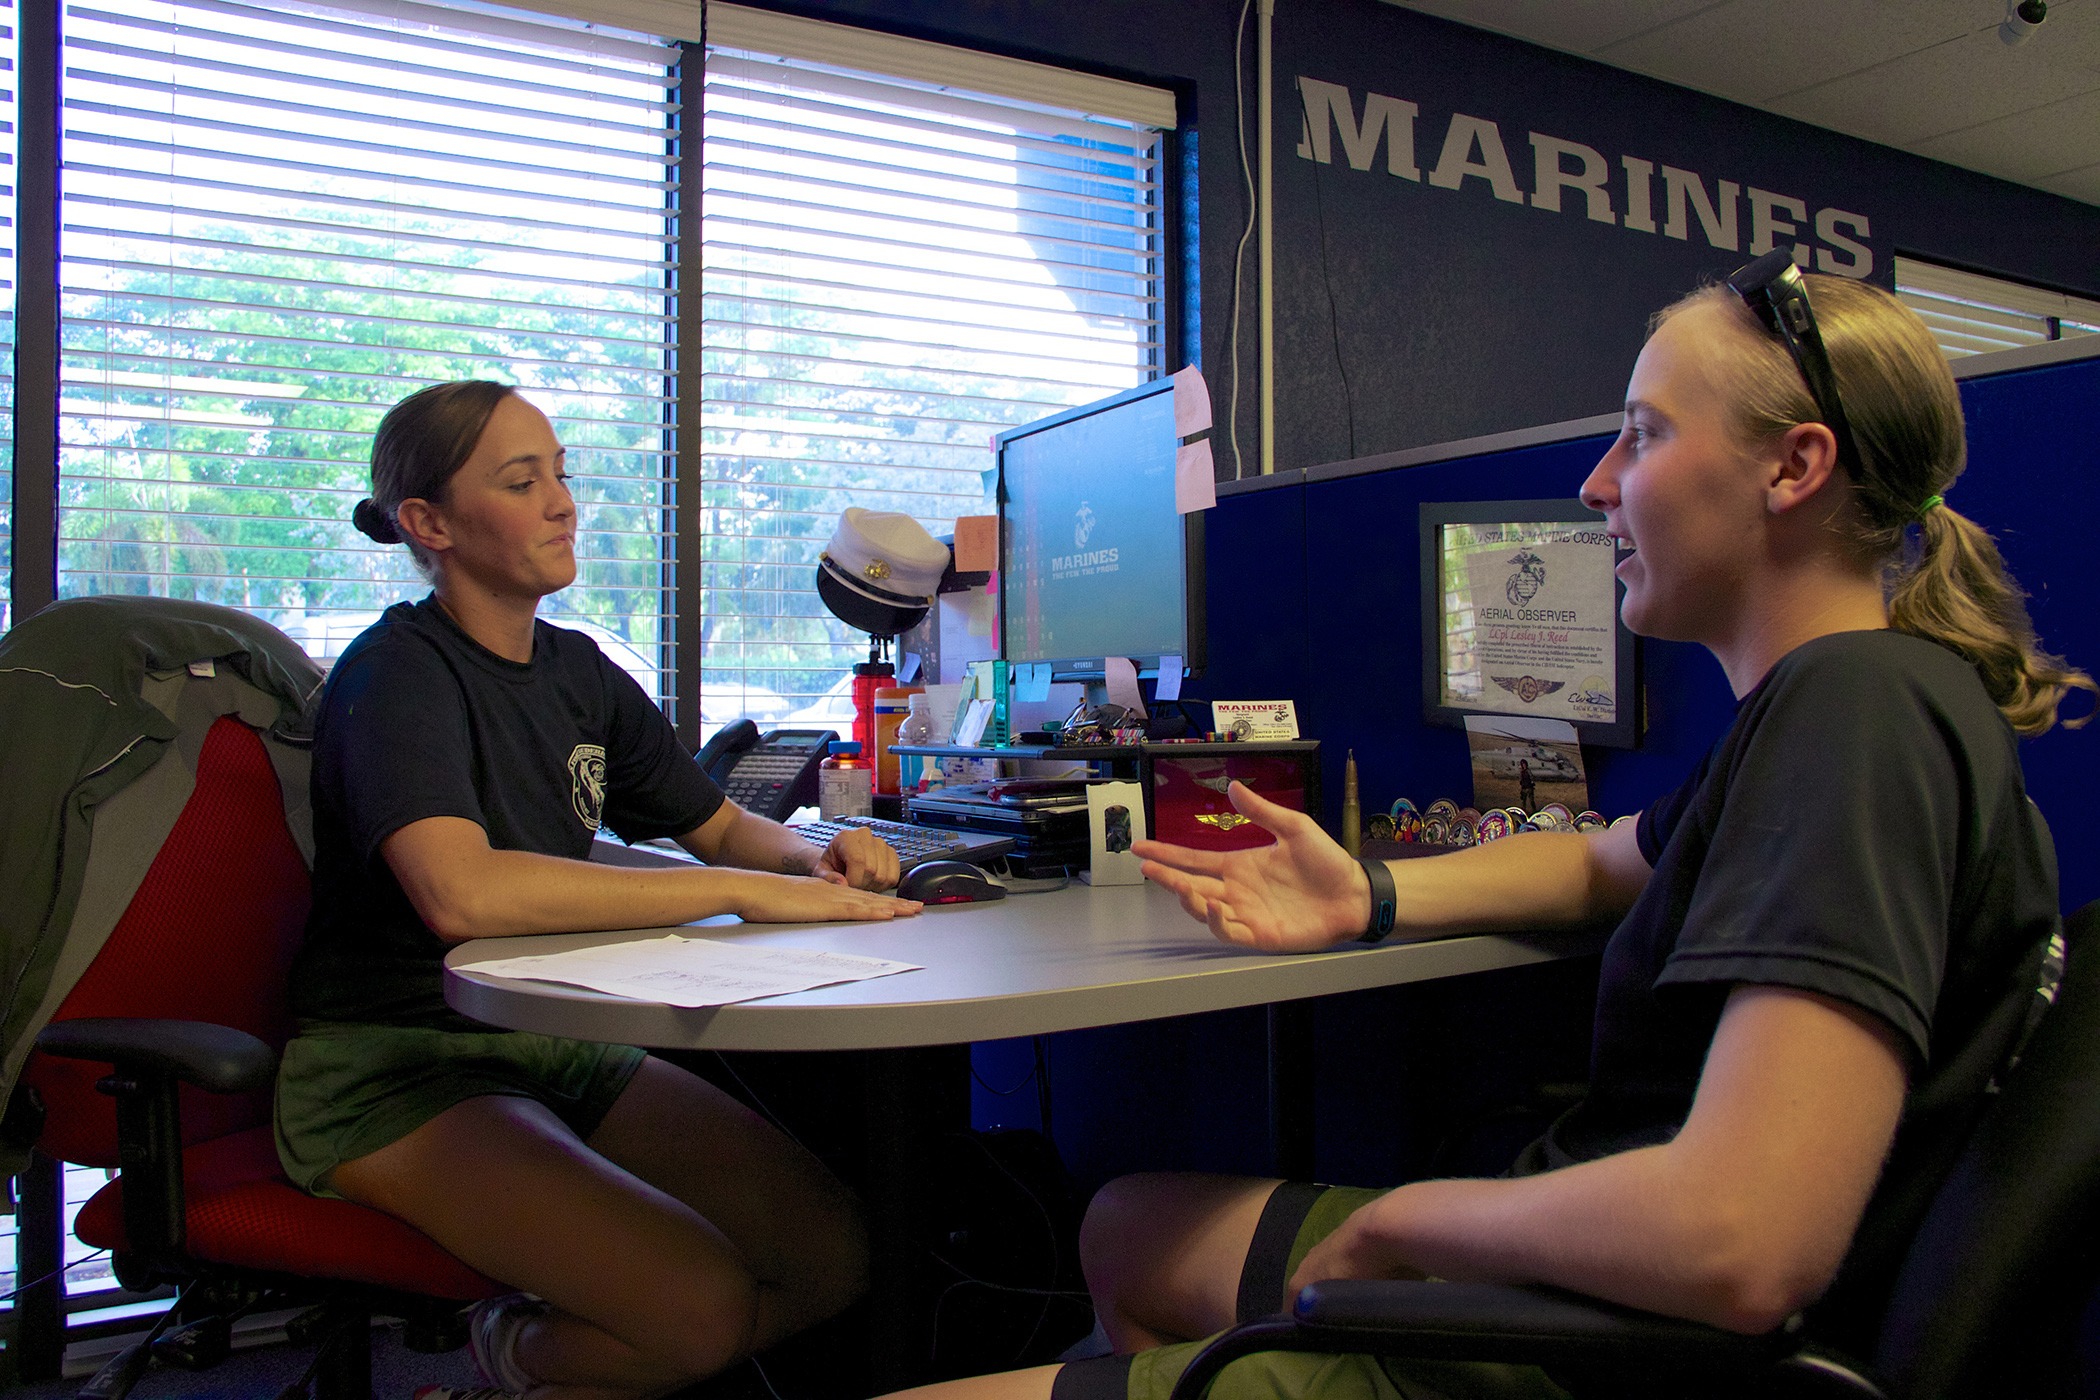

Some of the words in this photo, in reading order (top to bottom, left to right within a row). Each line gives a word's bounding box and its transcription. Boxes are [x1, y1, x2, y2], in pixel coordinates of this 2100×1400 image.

[1296, 75, 1874, 279] MARINES
[1573, 531, 1613, 547] CORPS
[1052, 548, 1119, 571] MARINES
[1052, 572, 1064, 580] THE
[1082, 567, 1095, 576] THE
[1480, 608, 1515, 620] AERIAL
[1517, 609, 1577, 622] OBSERVER
[1510, 629, 1536, 645] Lesley
[1547, 631, 1570, 644] Reed
